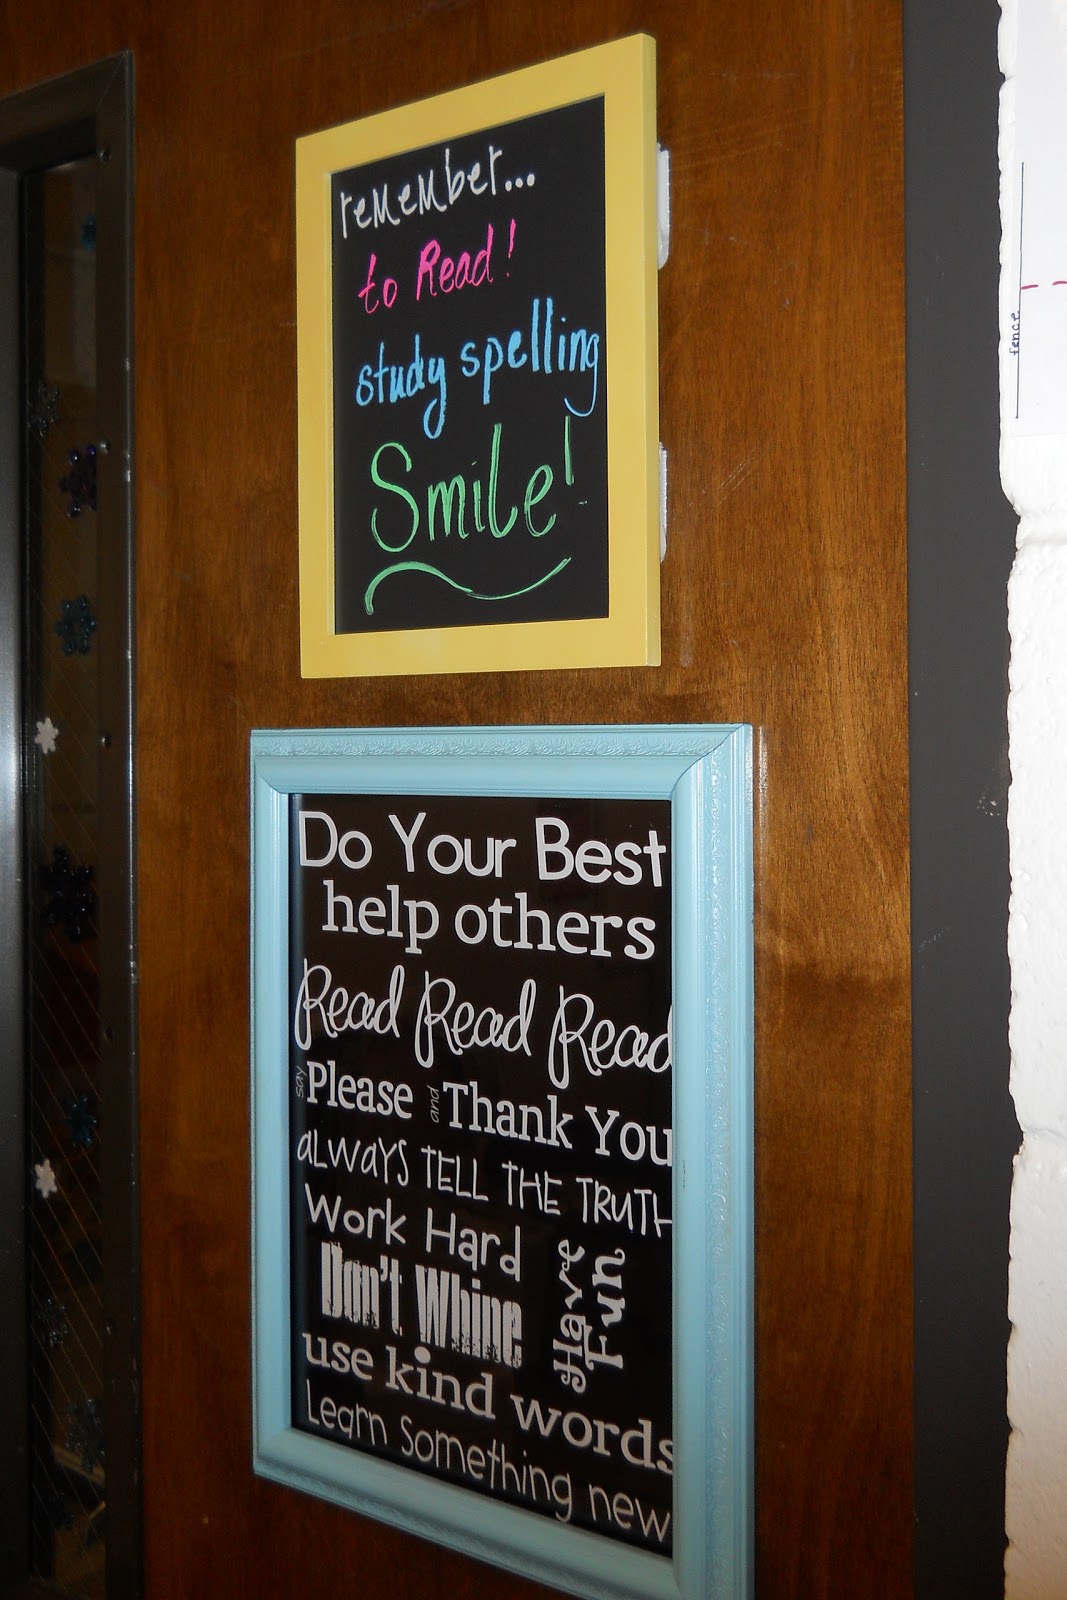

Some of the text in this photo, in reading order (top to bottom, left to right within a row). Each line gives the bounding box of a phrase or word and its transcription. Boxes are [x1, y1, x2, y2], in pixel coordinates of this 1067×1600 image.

[358, 253, 398, 314] to
[1008, 310, 1021, 356] fence
[356, 297, 600, 440] study spelling
[299, 811, 667, 887] Do Your Best
[322, 879, 657, 960] help others
[294, 958, 673, 1090] Read Read Read
[295, 1060, 673, 1168] say Please and Thank You
[304, 1183, 521, 1282] Work Hard
[420, 1144, 489, 1201] TELL
[501, 1160, 562, 1216] THE
[321, 1241, 523, 1369] Don't Whine
[552, 1239, 586, 1394] Have
[581, 1247, 626, 1371] Fun
[302, 1332, 673, 1474] use kind words
[305, 1378, 672, 1543] Learn Something new
